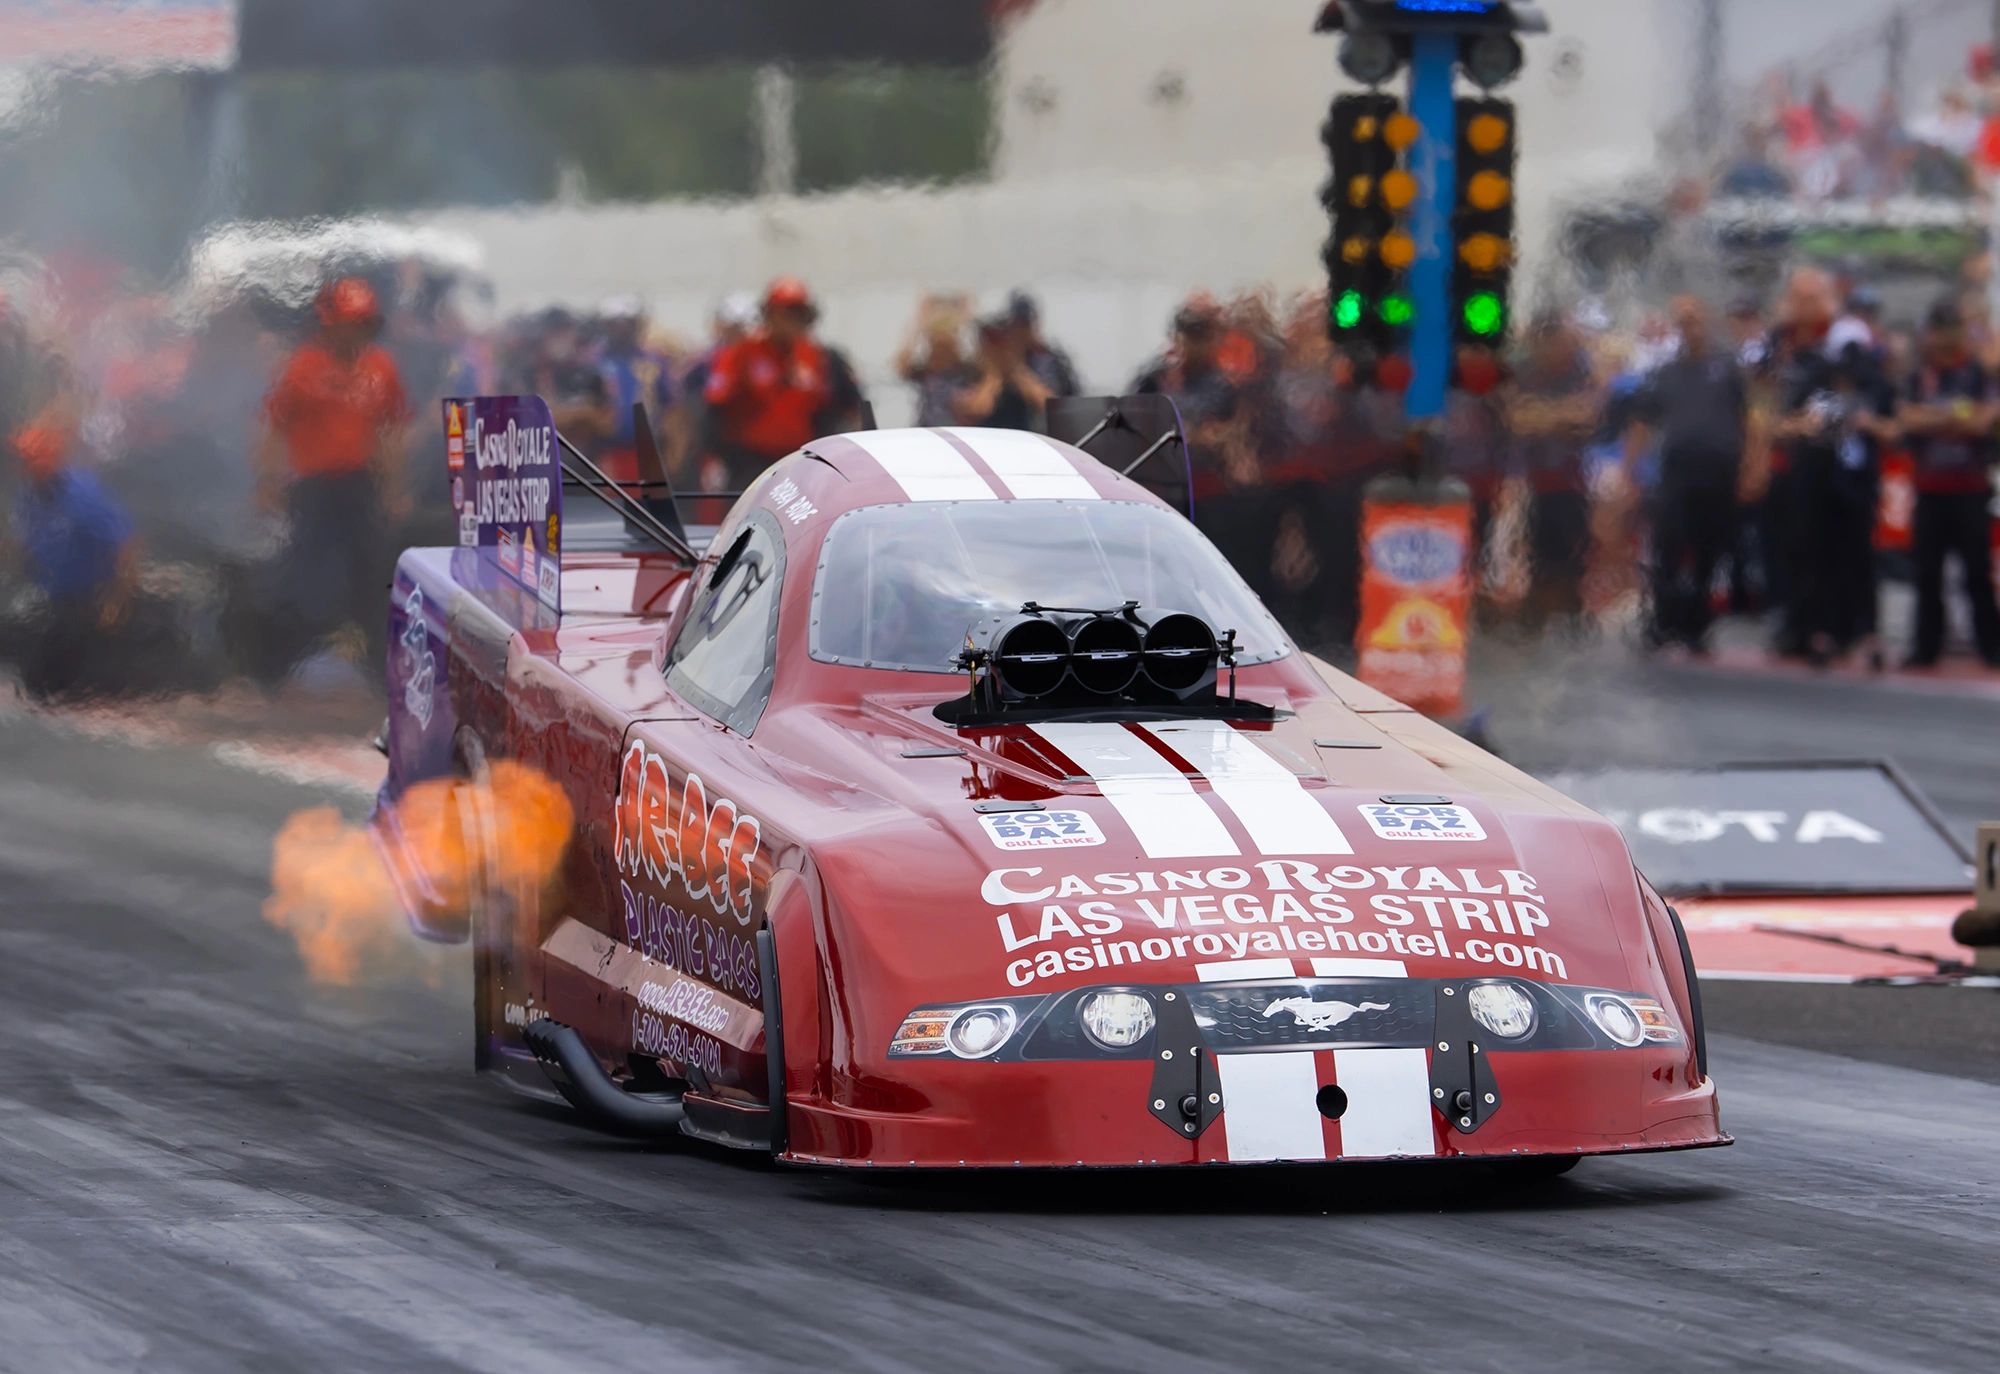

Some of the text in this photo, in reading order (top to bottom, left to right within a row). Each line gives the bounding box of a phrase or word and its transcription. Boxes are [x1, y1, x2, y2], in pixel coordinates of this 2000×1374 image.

[507, 417, 551, 473] ROYALE
[477, 477, 550, 524] LAS VEGAS STRIP
[986, 812, 1081, 826] ZOR
[994, 822, 1087, 839] BAZ
[1366, 806, 1461, 817] ZOR
[1375, 816, 1467, 831] BAZ
[1606, 806, 1884, 844] OTA
[1004, 837, 1097, 848] GULL LAKE
[1385, 830, 1478, 839] GULL LAKE
[980, 860, 1546, 906] CASINO ROYALE
[620, 878, 761, 1000] PLASTIC BAGS
[996, 893, 1551, 953] LAS VEGAS STRIP
[1005, 925, 1569, 987] casinoroyalehotel.com
